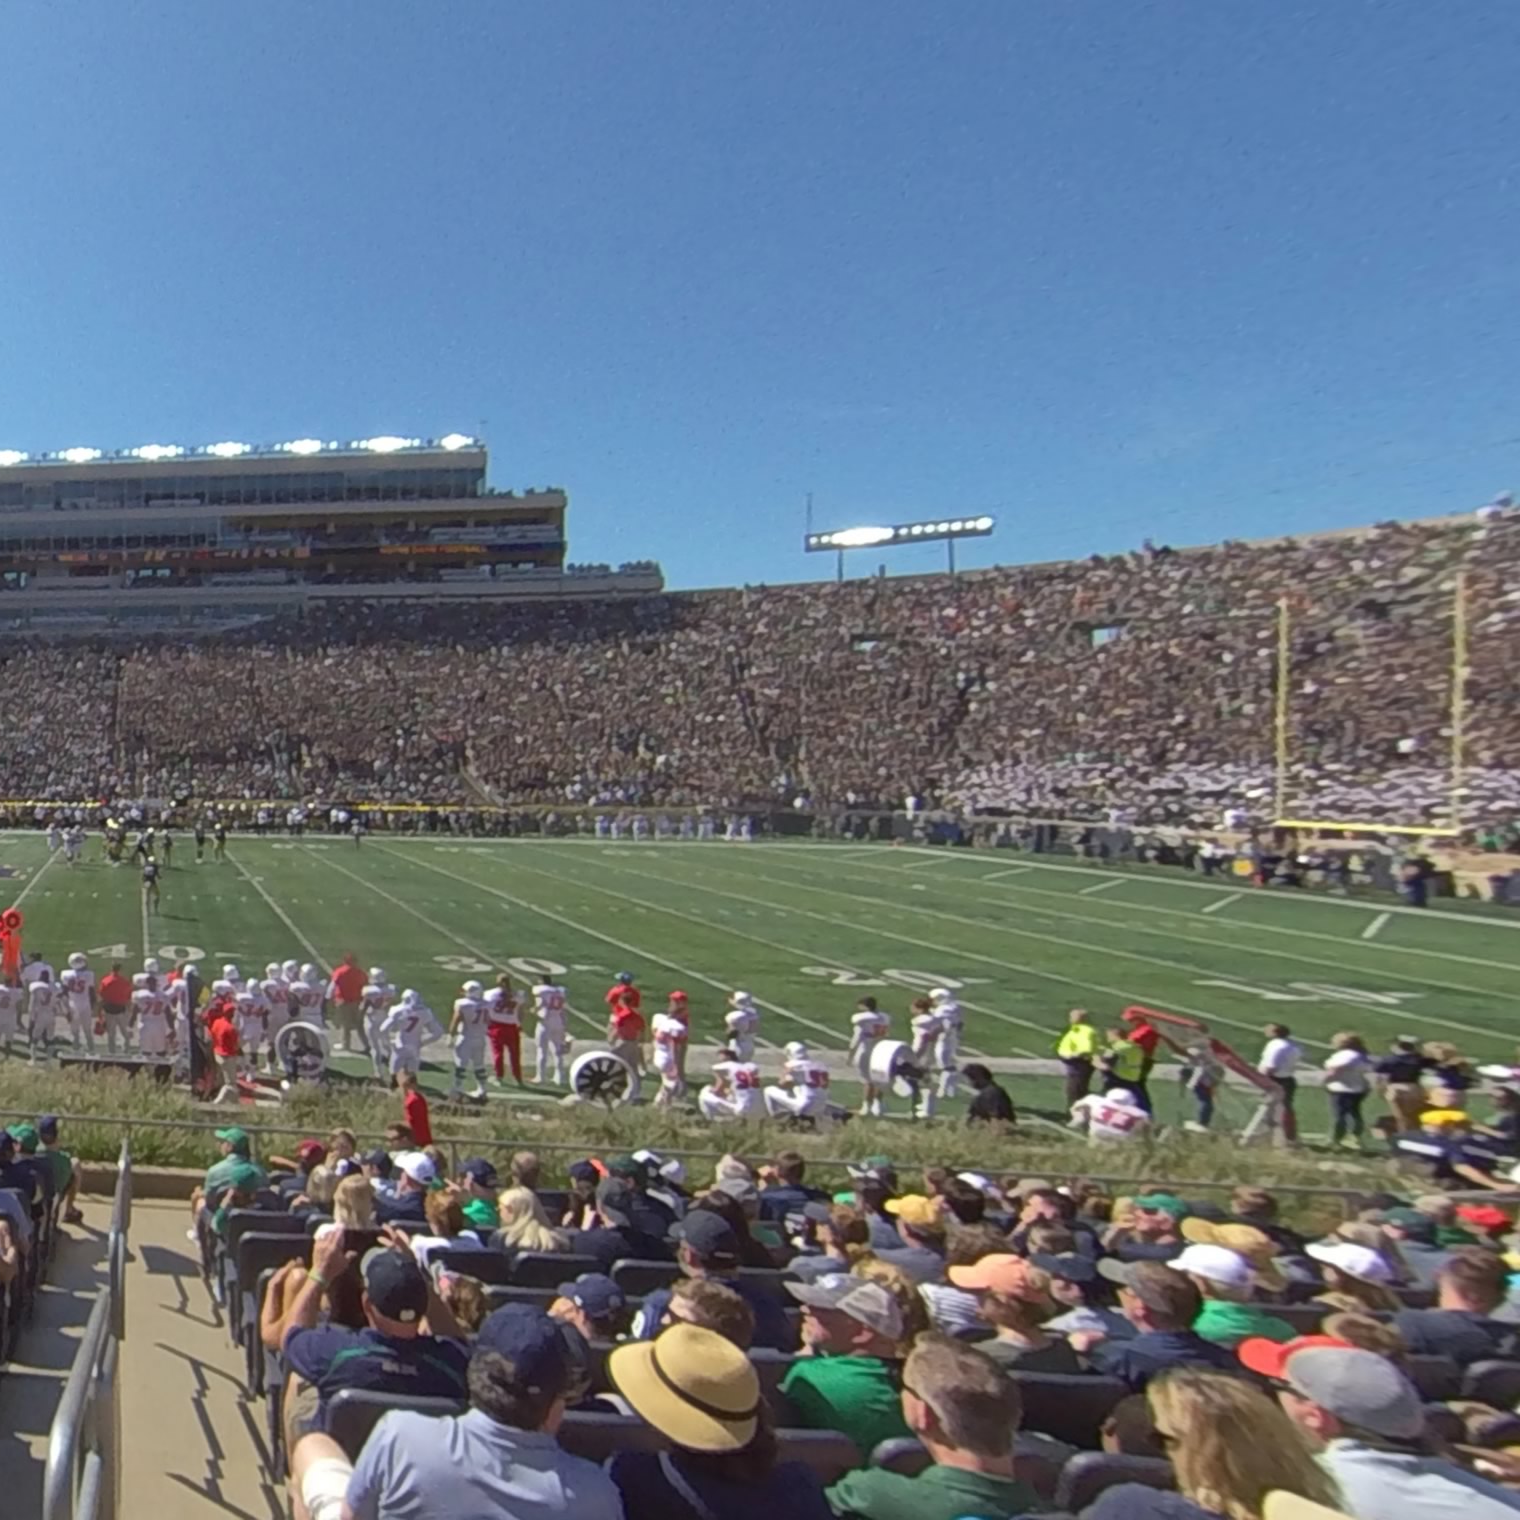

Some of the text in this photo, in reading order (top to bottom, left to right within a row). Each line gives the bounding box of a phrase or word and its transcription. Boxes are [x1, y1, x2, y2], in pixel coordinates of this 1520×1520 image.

[87, 943, 206, 961] 40
[432, 955, 568, 975] 30
[799, 966, 964, 988] 20
